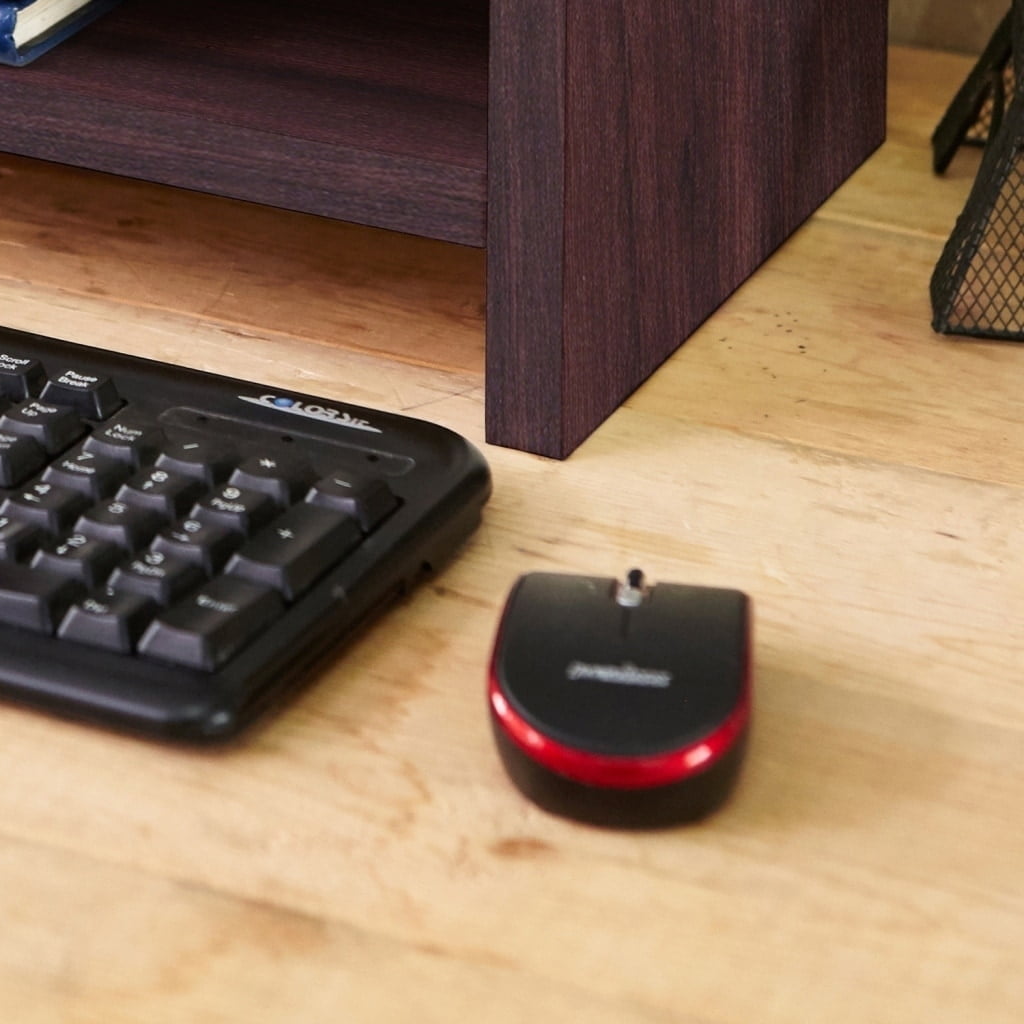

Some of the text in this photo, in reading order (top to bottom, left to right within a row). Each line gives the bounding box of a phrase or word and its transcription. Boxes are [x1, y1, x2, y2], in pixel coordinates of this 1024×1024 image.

[57, 376, 89, 389] Break
[64, 369, 99, 384] Pause
[21, 406, 39, 417] Up
[62, 460, 95, 474] Home
